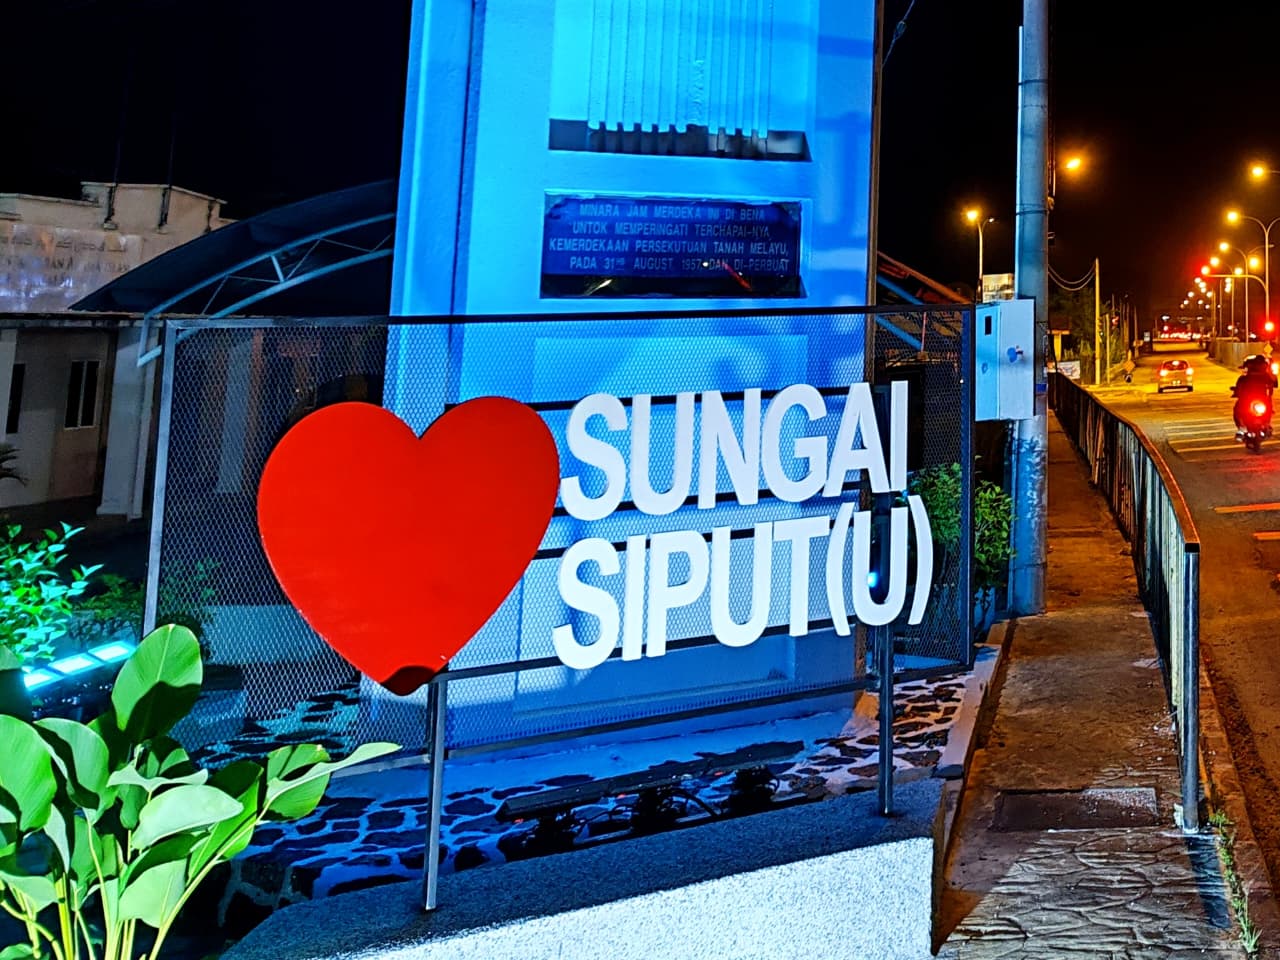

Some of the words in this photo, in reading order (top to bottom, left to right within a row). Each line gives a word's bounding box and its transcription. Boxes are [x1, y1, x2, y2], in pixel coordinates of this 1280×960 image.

[627, 205, 648, 217] JAM
[654, 205, 701, 219] MERDEKA
[725, 208, 735, 220] DI
[572, 222, 608, 234] UNTOK
[614, 222, 688, 236] MEMPERINGATI
[549, 238, 629, 252] KEMERDEKAAN
[635, 240, 707, 253] PERSEKUTUAN
[714, 242, 744, 254] TANAH
[570, 256, 597, 269] PADA
[634, 257, 674, 270] AUGUST
[709, 259, 728, 270] DAN
[734, 258, 789, 271] DI-PERBUAT
[560, 380, 909, 522] SUNGAI
[552, 495, 934, 670] SIPUT(U)
